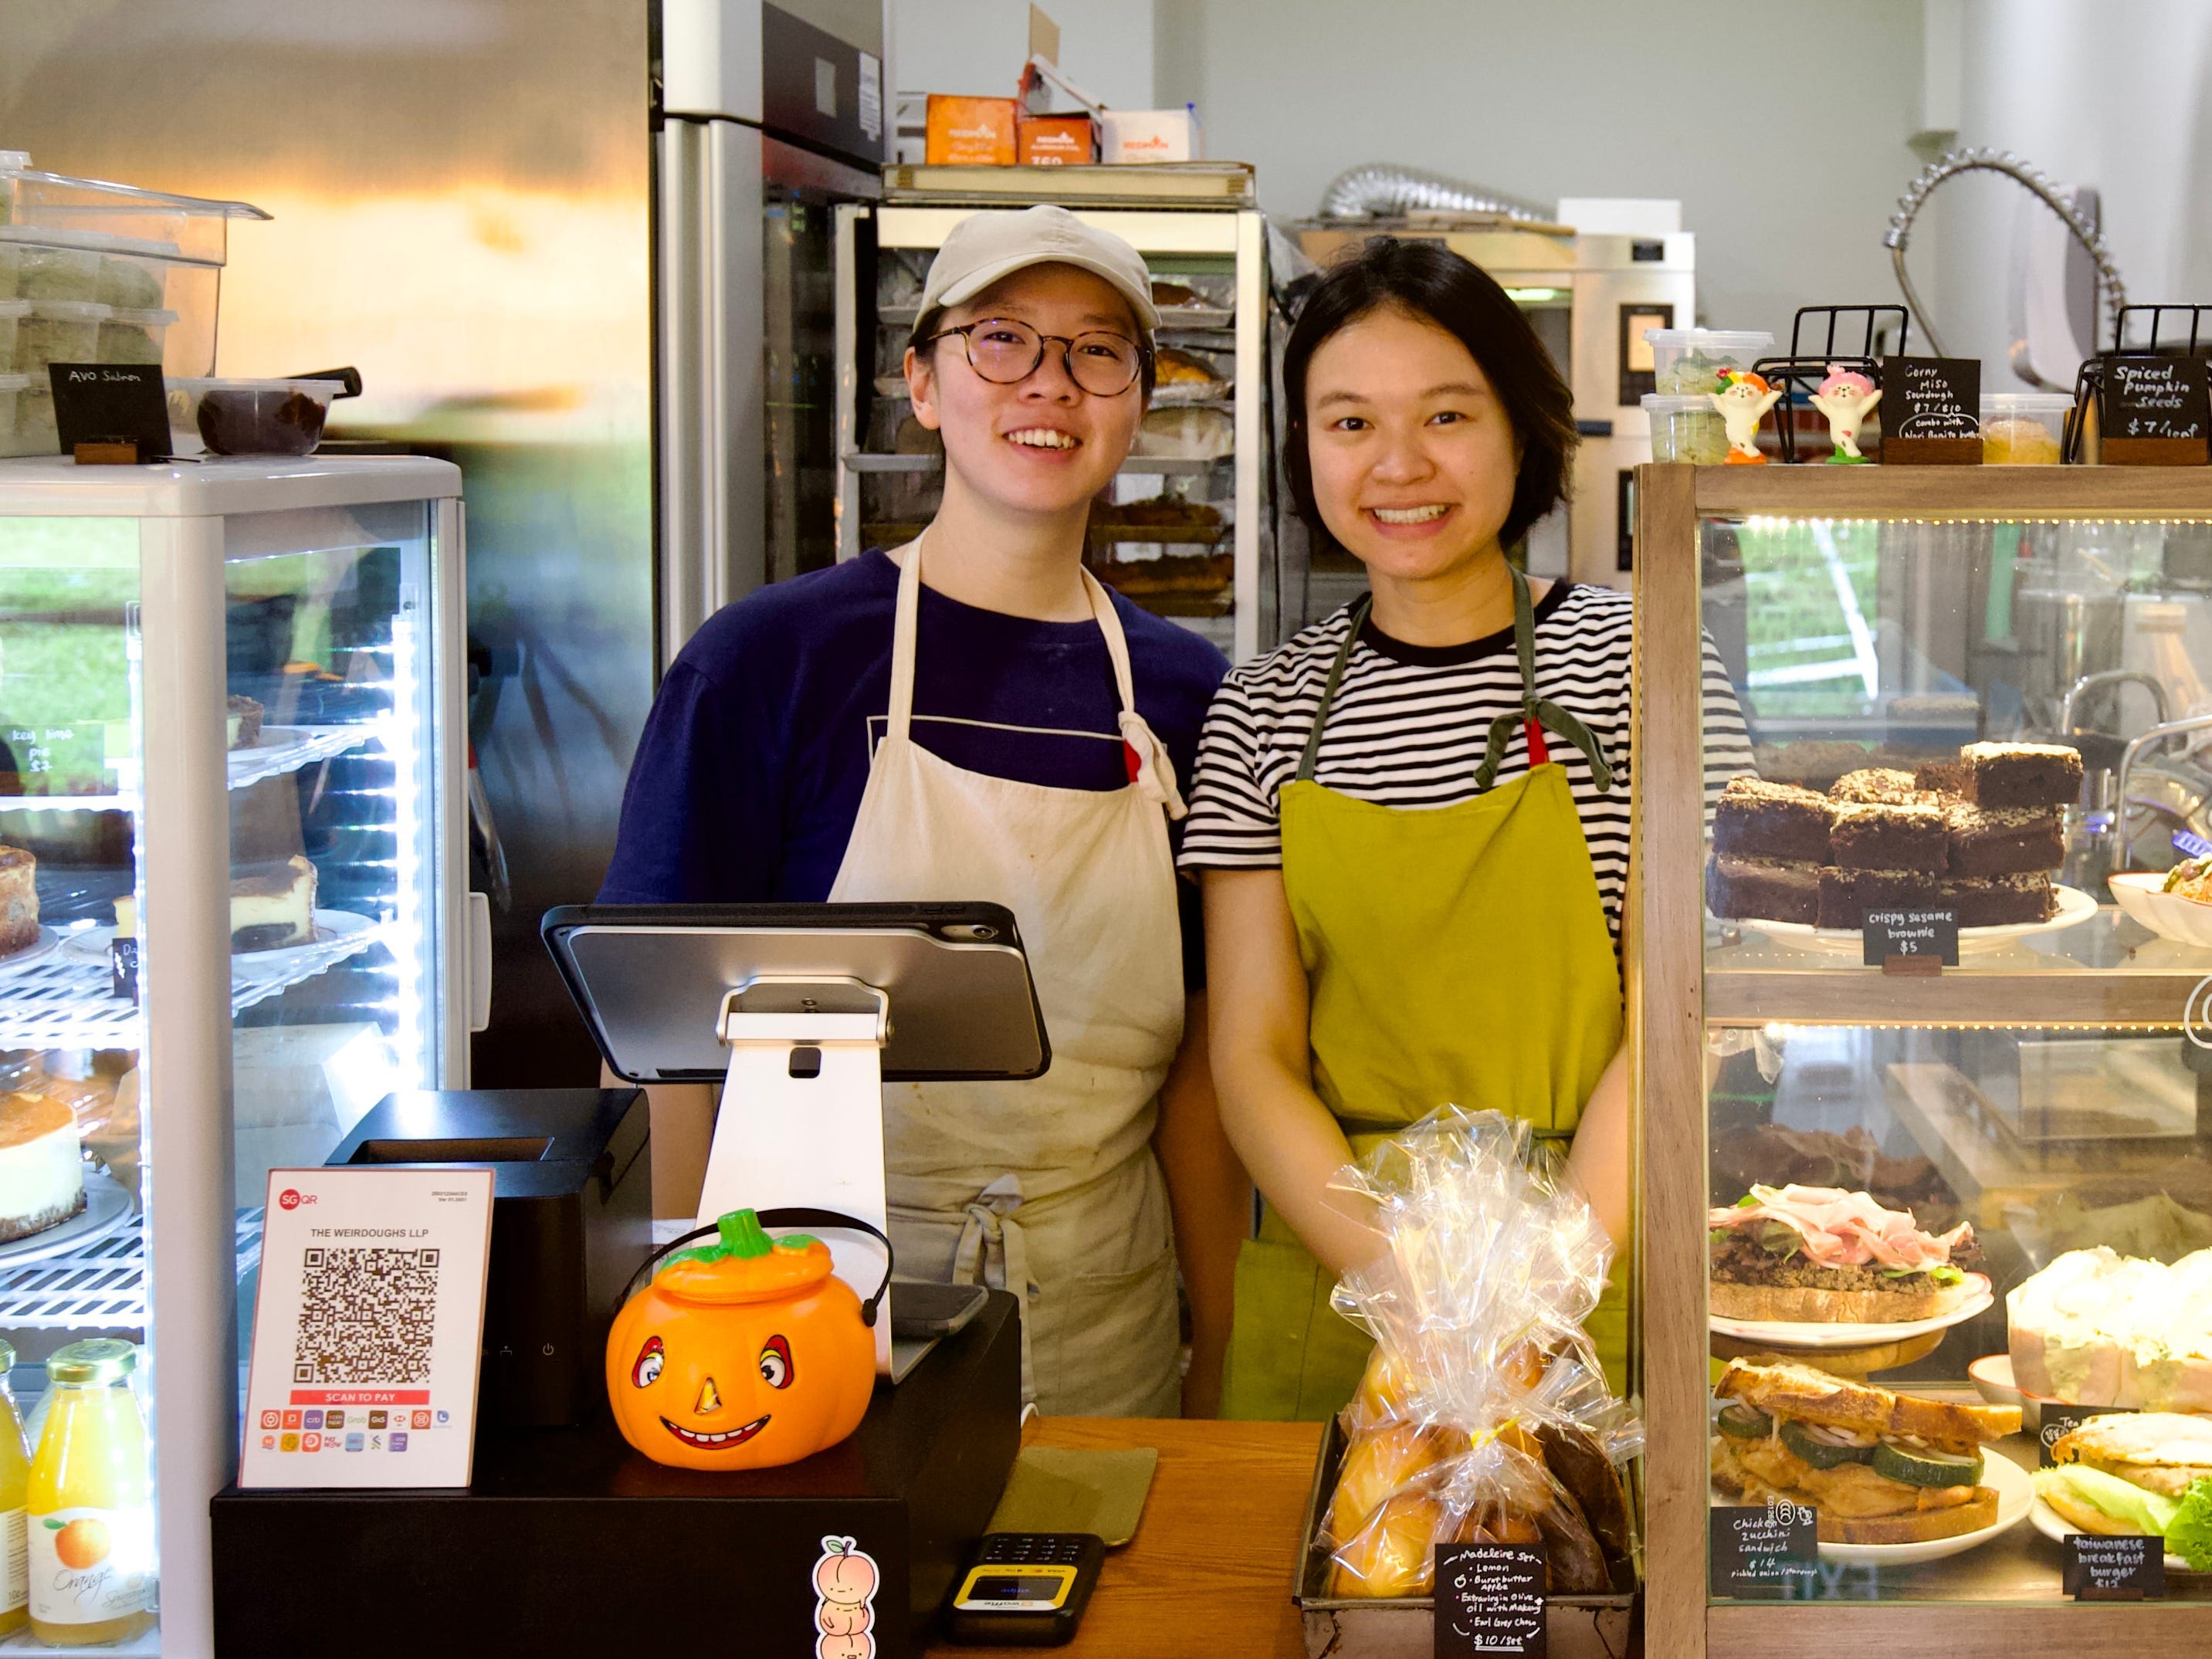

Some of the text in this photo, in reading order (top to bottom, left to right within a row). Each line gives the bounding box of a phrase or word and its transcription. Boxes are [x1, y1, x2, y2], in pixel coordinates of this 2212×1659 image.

[2113, 364, 2174, 383] Spiced
[1868, 912, 1905, 926] crispy
[1888, 926, 1935, 939] brownie
[1899, 940, 1918, 956] $5
[334, 1229, 406, 1237] WEIRDOUGHS
[325, 1393, 356, 1401] SCAN
[1460, 1547, 1515, 1562] Madeleine
[2078, 1551, 2146, 1566] breakfast
[1476, 1563, 1509, 1573] Lemon
[2090, 1566, 2137, 1581] burger
[1474, 1617, 1491, 1627] Earl
